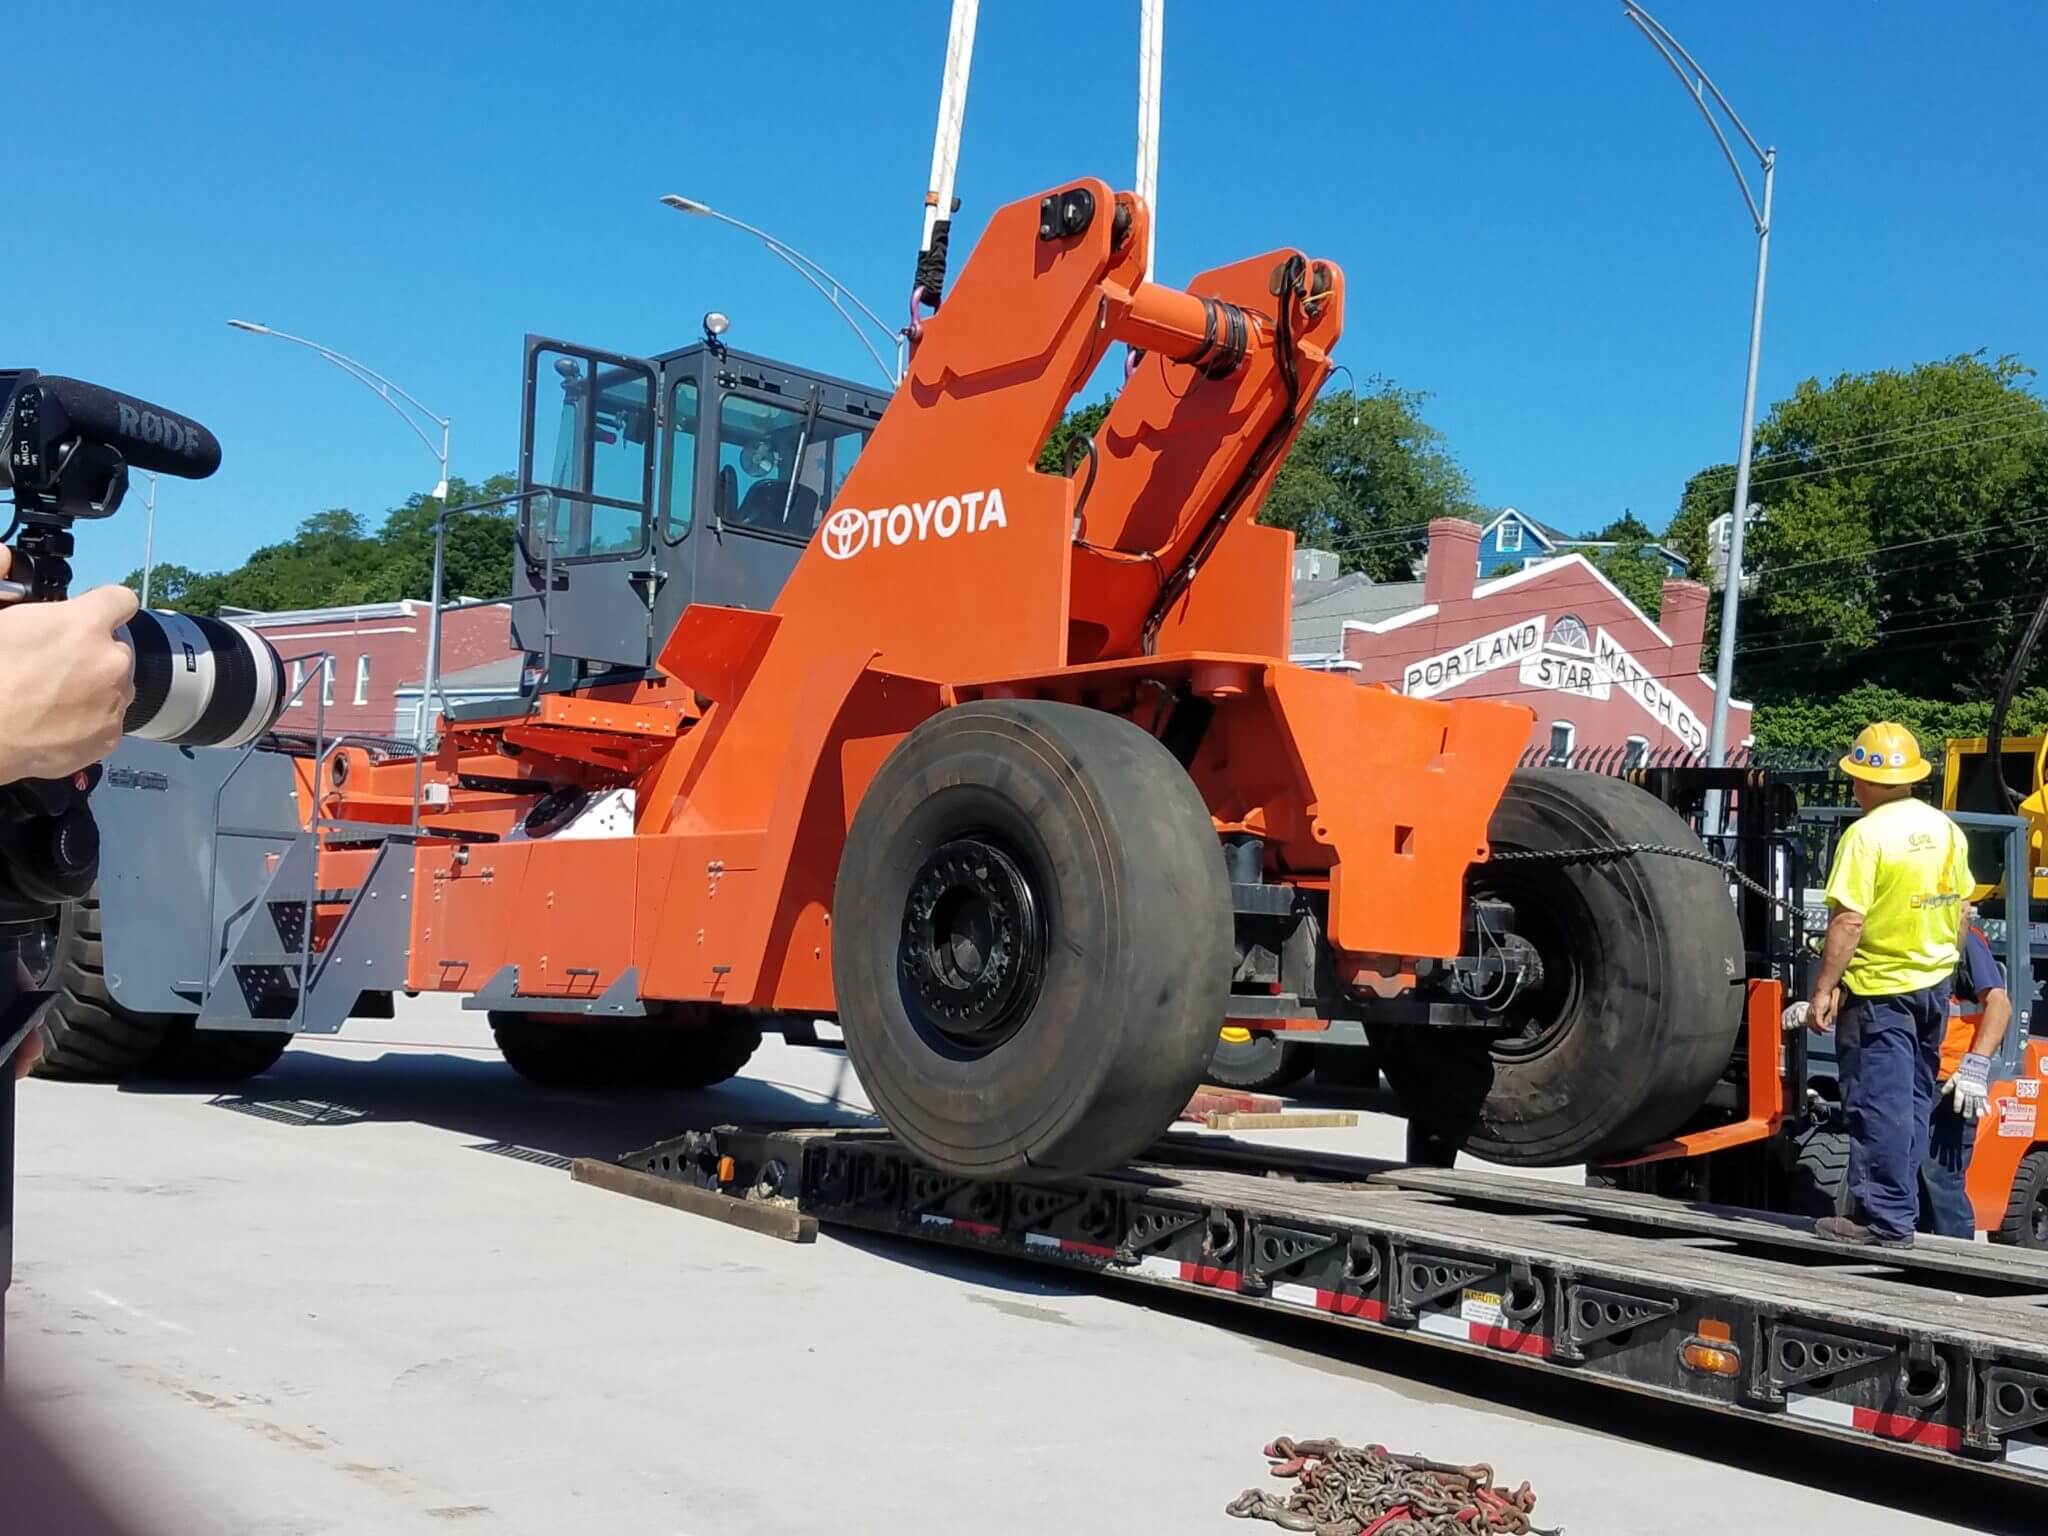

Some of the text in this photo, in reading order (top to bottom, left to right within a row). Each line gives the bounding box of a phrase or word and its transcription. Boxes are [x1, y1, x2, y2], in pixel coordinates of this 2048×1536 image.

[867, 488, 1007, 548] TOYOTA
[1408, 624, 1537, 696] PORTLAND
[1537, 657, 1592, 692] STAR
[1599, 636, 1672, 724] MATCH
[1471, 1291, 1503, 1305] CAUTIO
